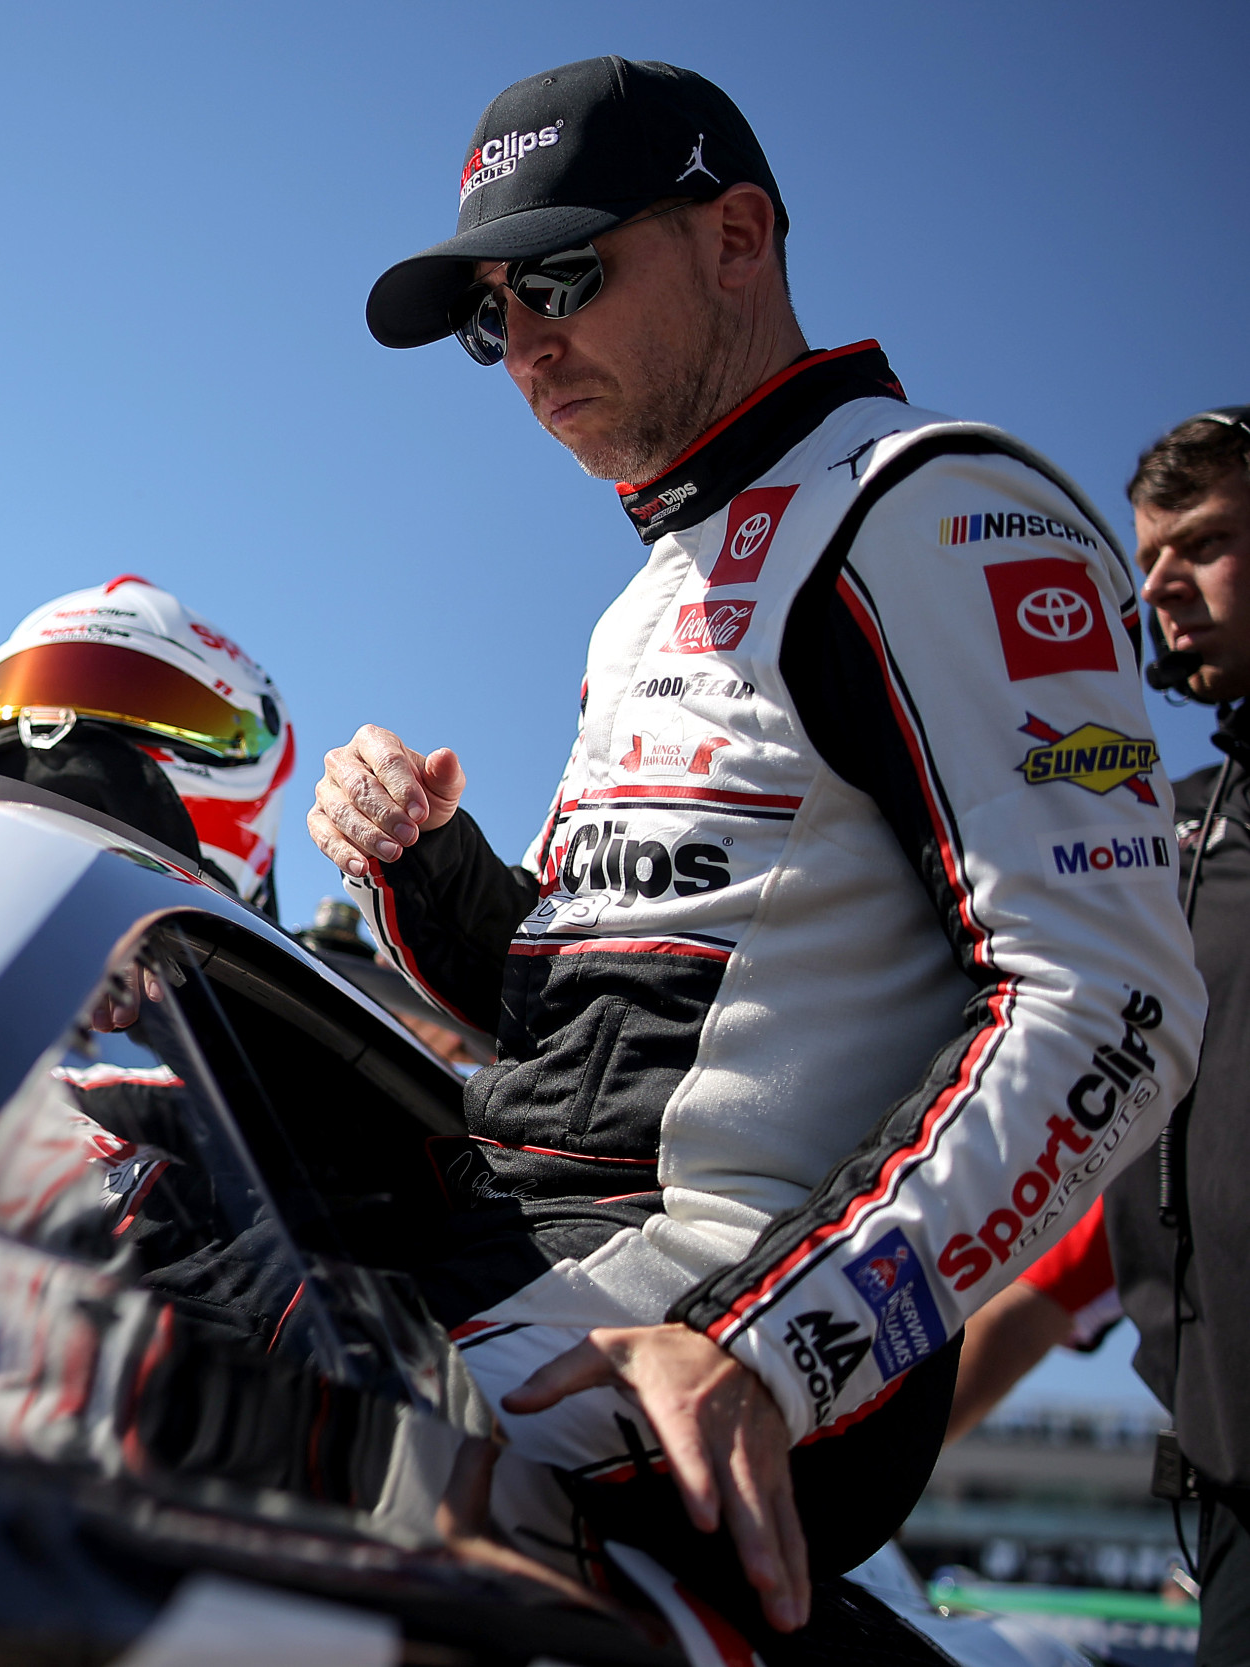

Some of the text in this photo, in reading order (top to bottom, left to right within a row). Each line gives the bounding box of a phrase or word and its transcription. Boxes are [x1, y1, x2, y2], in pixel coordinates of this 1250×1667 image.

[460, 126, 559, 180] rtClips
[642, 756, 690, 767] HAWAIIAN
[651, 744, 682, 755] KING'S
[1030, 744, 1151, 780] SUNOCO
[539, 820, 731, 908] Clips
[1052, 836, 1149, 875] Mobil
[937, 986, 1163, 1293] SportClips
[1019, 1087, 1151, 1248] HAIRCUTS
[794, 1309, 872, 1402] MA
[899, 1280, 931, 1356] SHERWIN
[784, 1319, 831, 1426] TOOL
